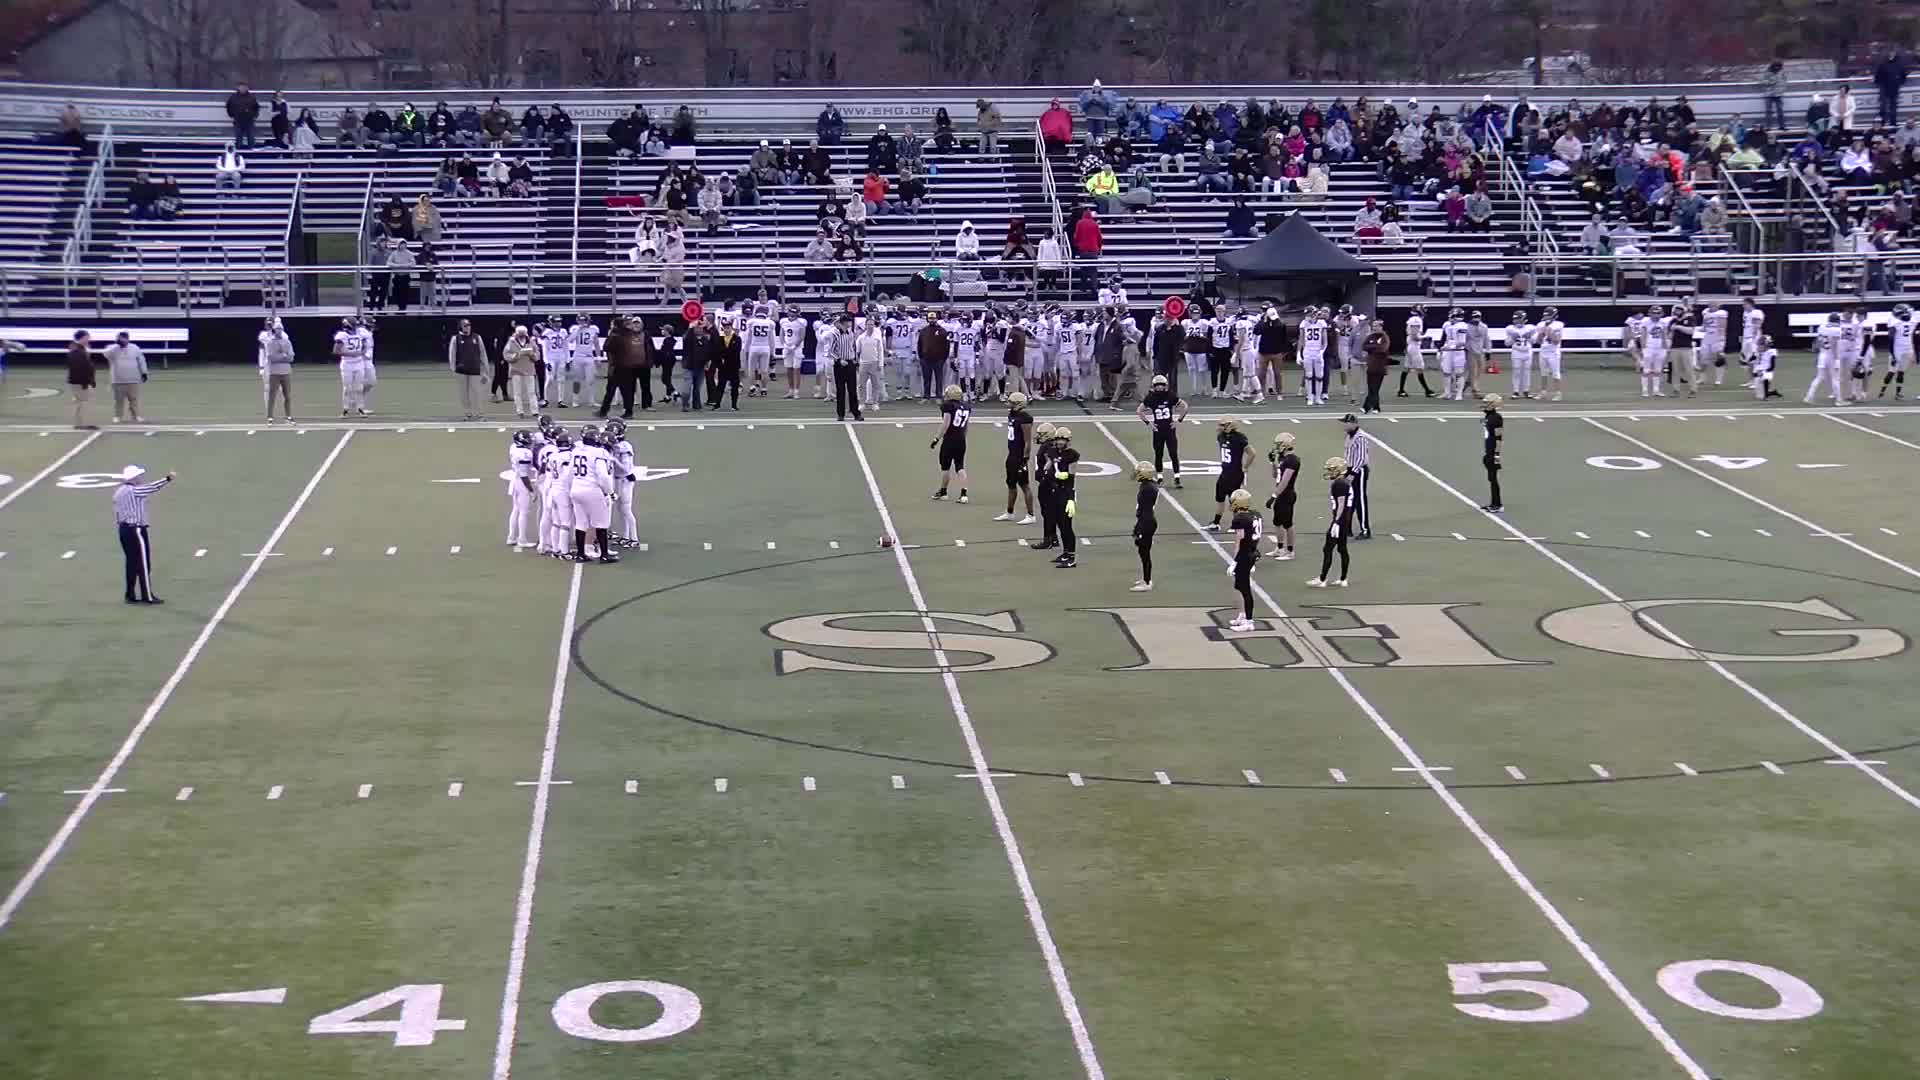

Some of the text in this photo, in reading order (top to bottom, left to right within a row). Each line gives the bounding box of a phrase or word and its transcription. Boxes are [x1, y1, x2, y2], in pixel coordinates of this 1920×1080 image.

[753, 326, 769, 337] 65
[896, 324, 909, 338] 73
[1217, 325, 1228, 338] 47
[1307, 328, 1320, 341] 35
[580, 332, 591, 345] 12
[960, 332, 974, 345] 26
[952, 409, 969, 428] 67
[1154, 407, 1171, 420] 23
[573, 455, 587, 477] 56
